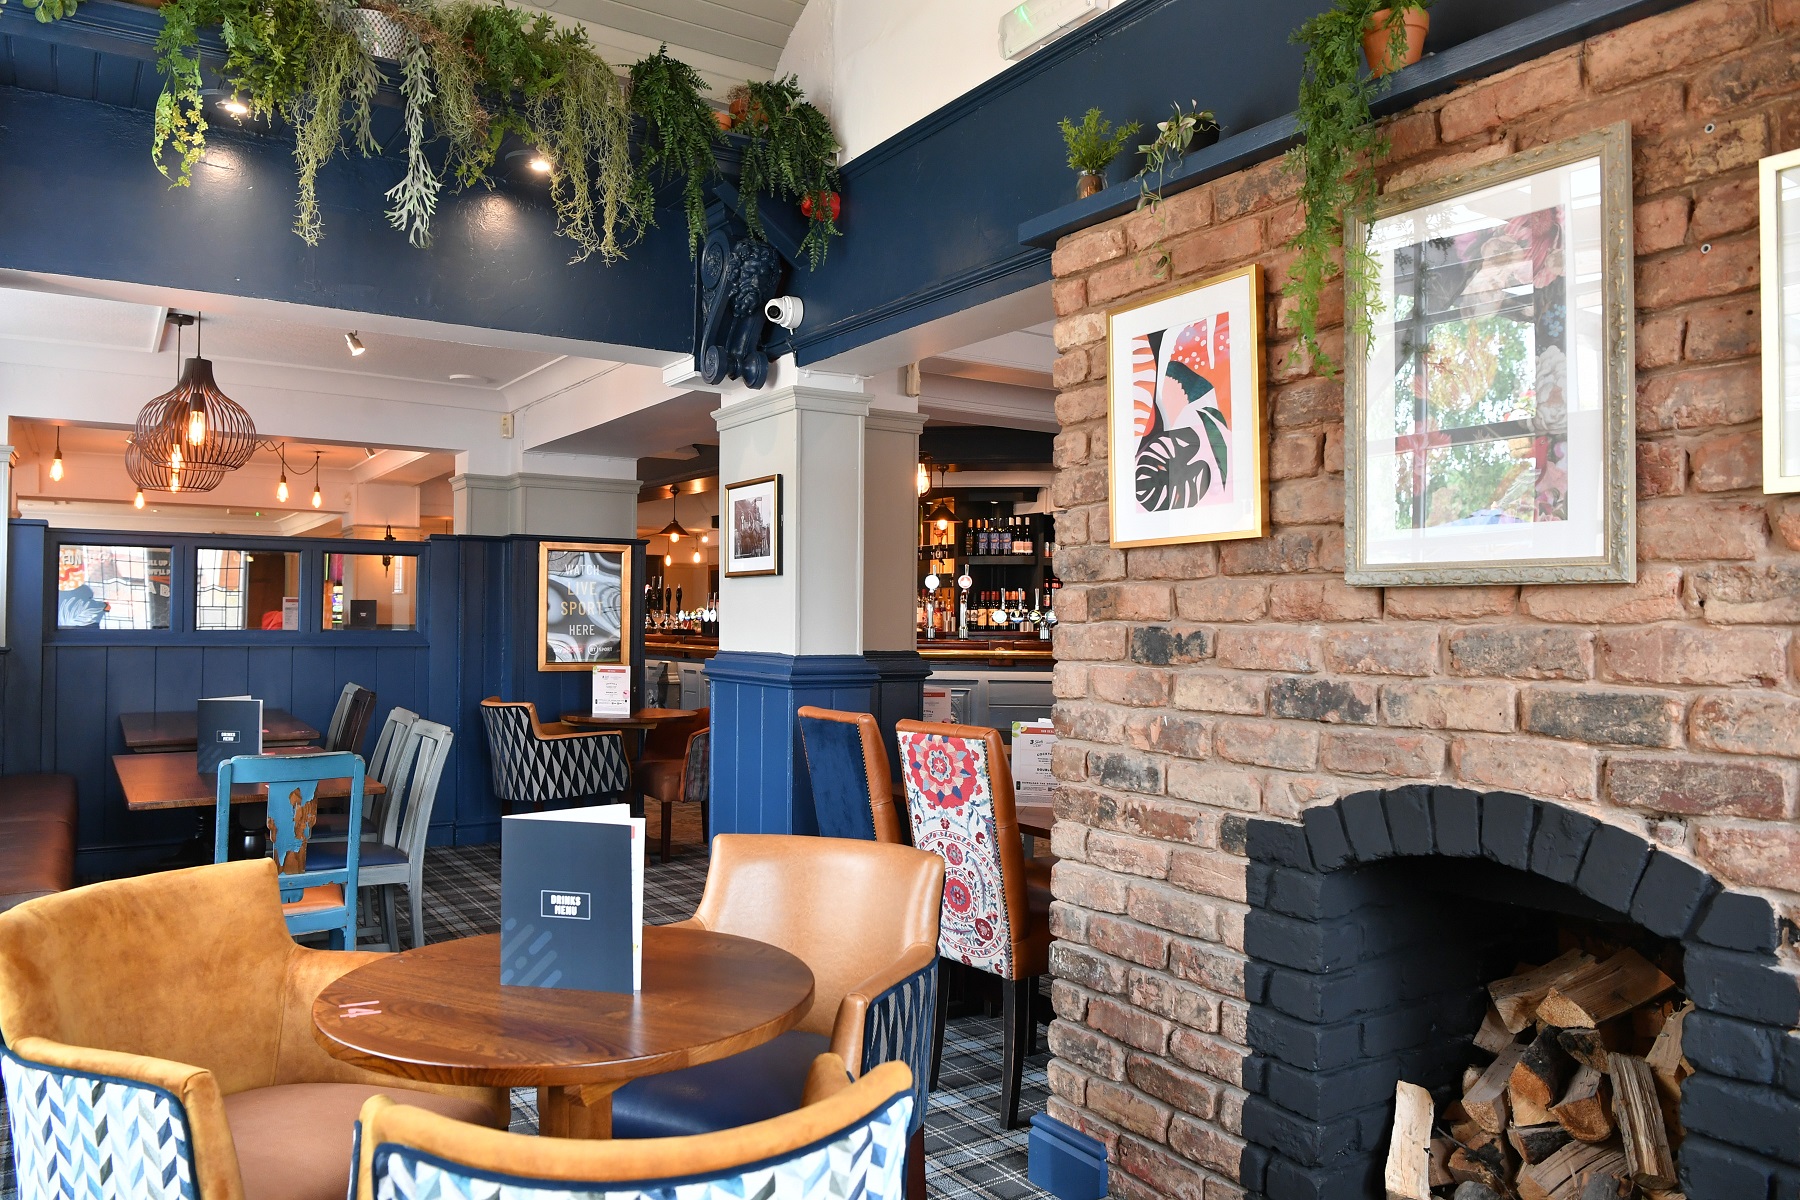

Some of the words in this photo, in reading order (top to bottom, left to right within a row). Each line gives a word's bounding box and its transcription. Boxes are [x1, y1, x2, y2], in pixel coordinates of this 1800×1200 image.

[565, 564, 600, 576] WATCH
[568, 582, 597, 596] LIVE
[560, 601, 604, 616] SPORT
[569, 624, 596, 636] HERE
[551, 895, 581, 906] DRINKS
[554, 905, 577, 916] MENU
